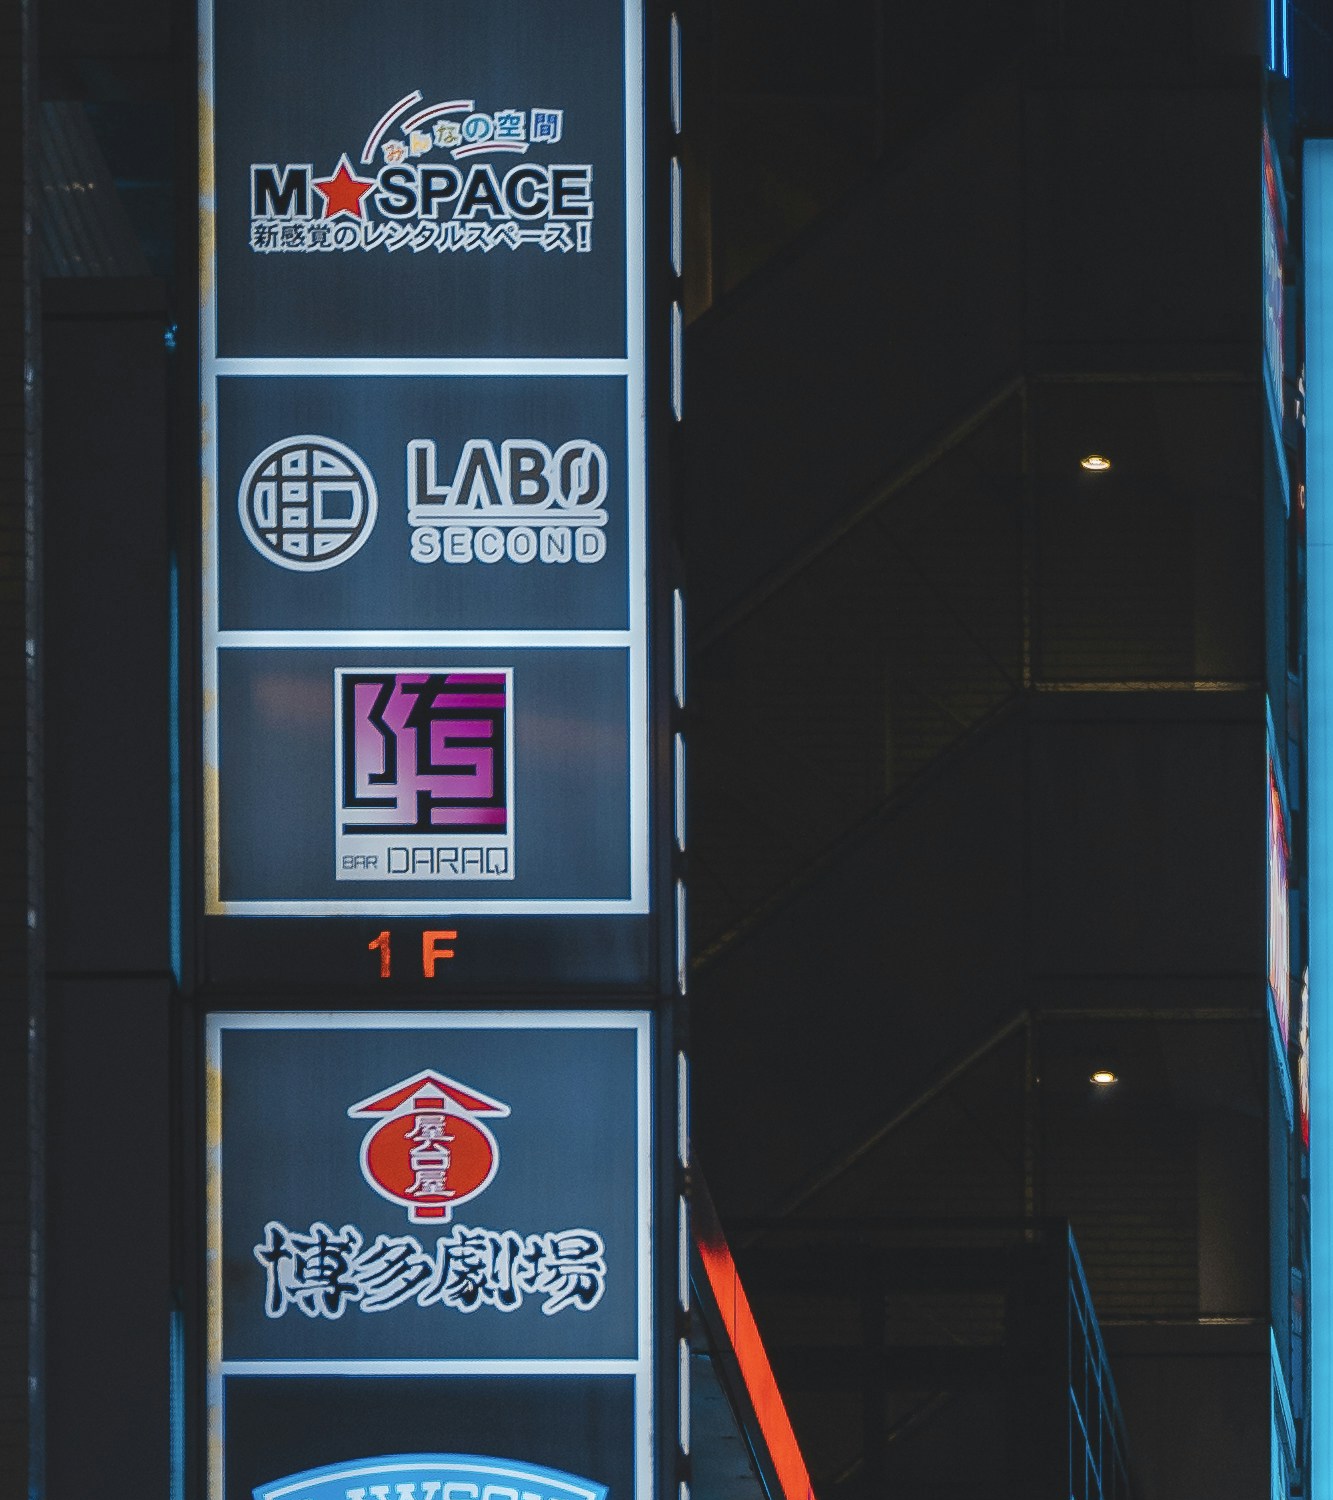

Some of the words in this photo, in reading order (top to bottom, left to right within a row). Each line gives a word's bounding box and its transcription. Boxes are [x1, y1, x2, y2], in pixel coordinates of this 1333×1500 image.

[411, 528, 606, 561] SECOND
[342, 855, 378, 870] BAR
[404, 1114, 455, 1197] 屋台屋
[258, 1224, 604, 1317] 博多劇場
